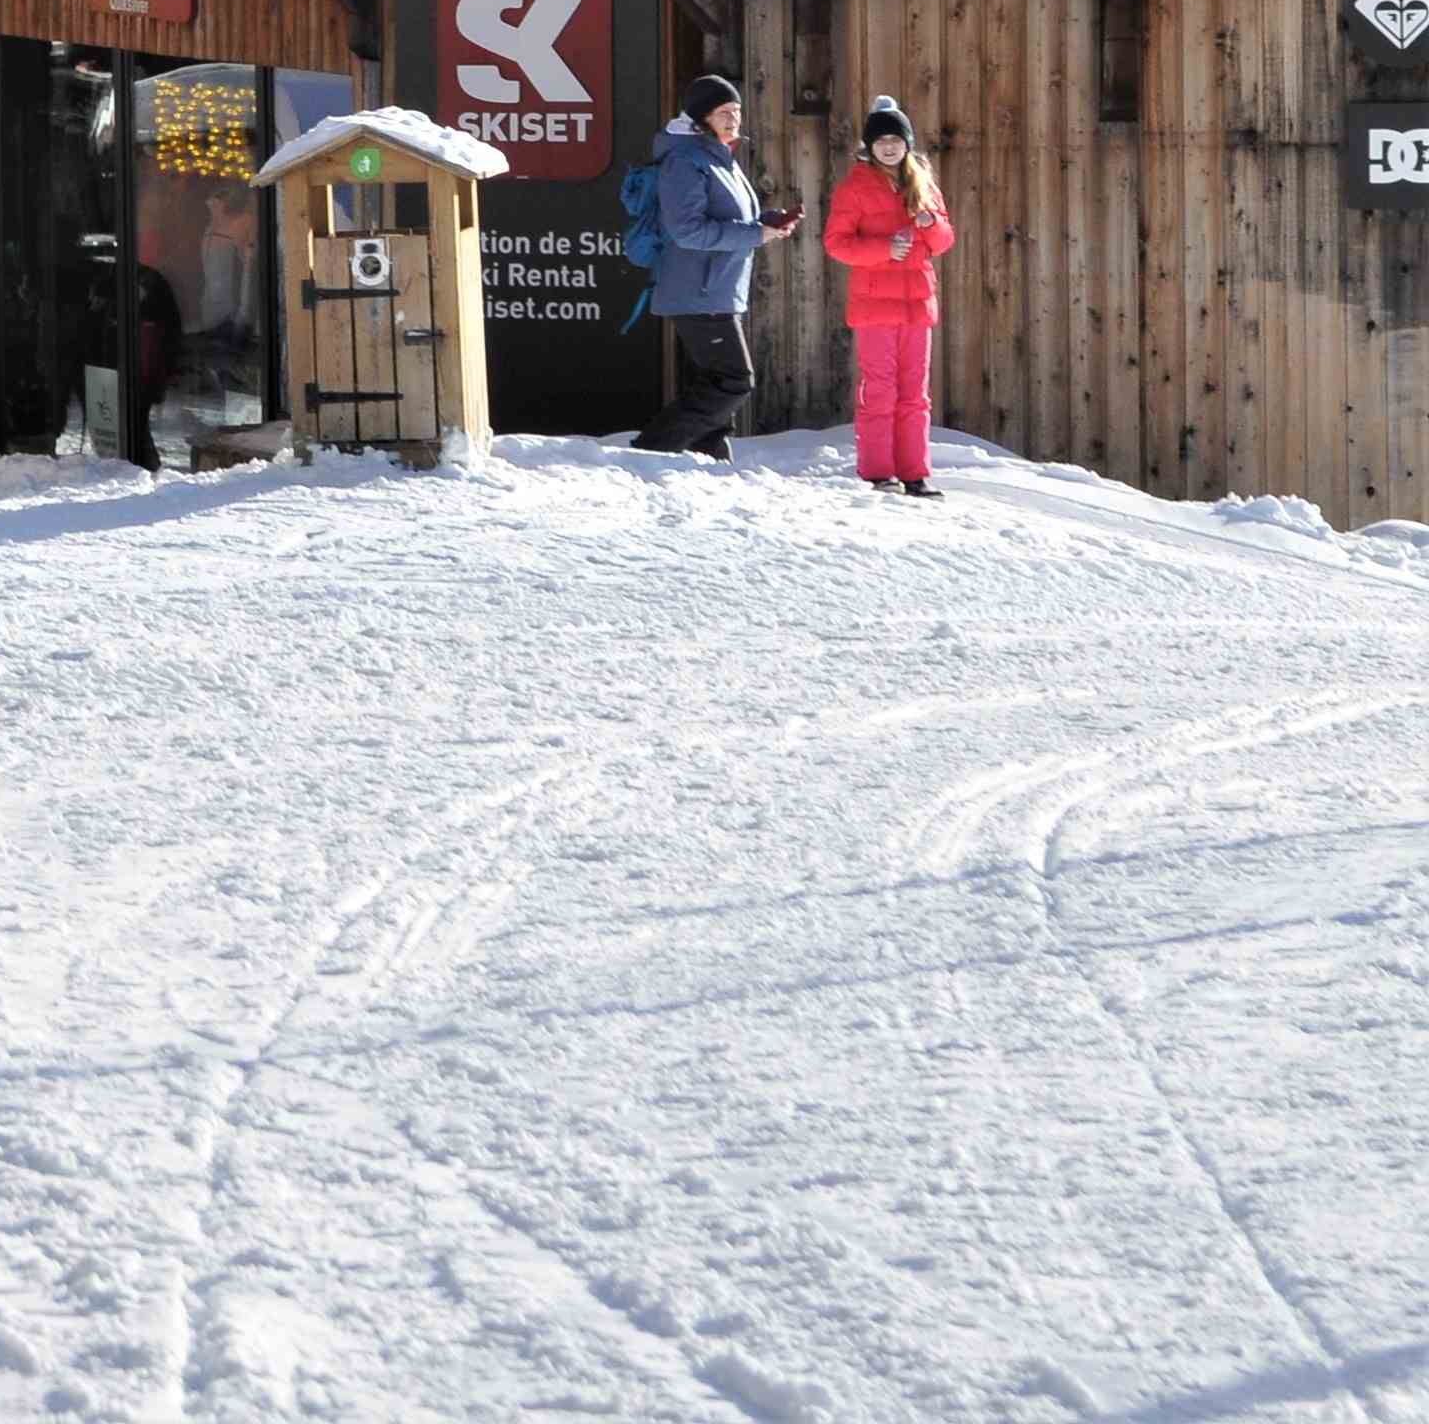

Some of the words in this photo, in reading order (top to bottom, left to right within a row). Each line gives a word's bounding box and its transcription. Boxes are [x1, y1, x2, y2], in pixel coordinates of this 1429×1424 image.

[457, 111, 594, 143] SKISET
[480, 229, 530, 254] tion
[539, 231, 572, 254] de
[508, 263, 598, 288] Rental
[484, 295, 601, 320] iset.com
